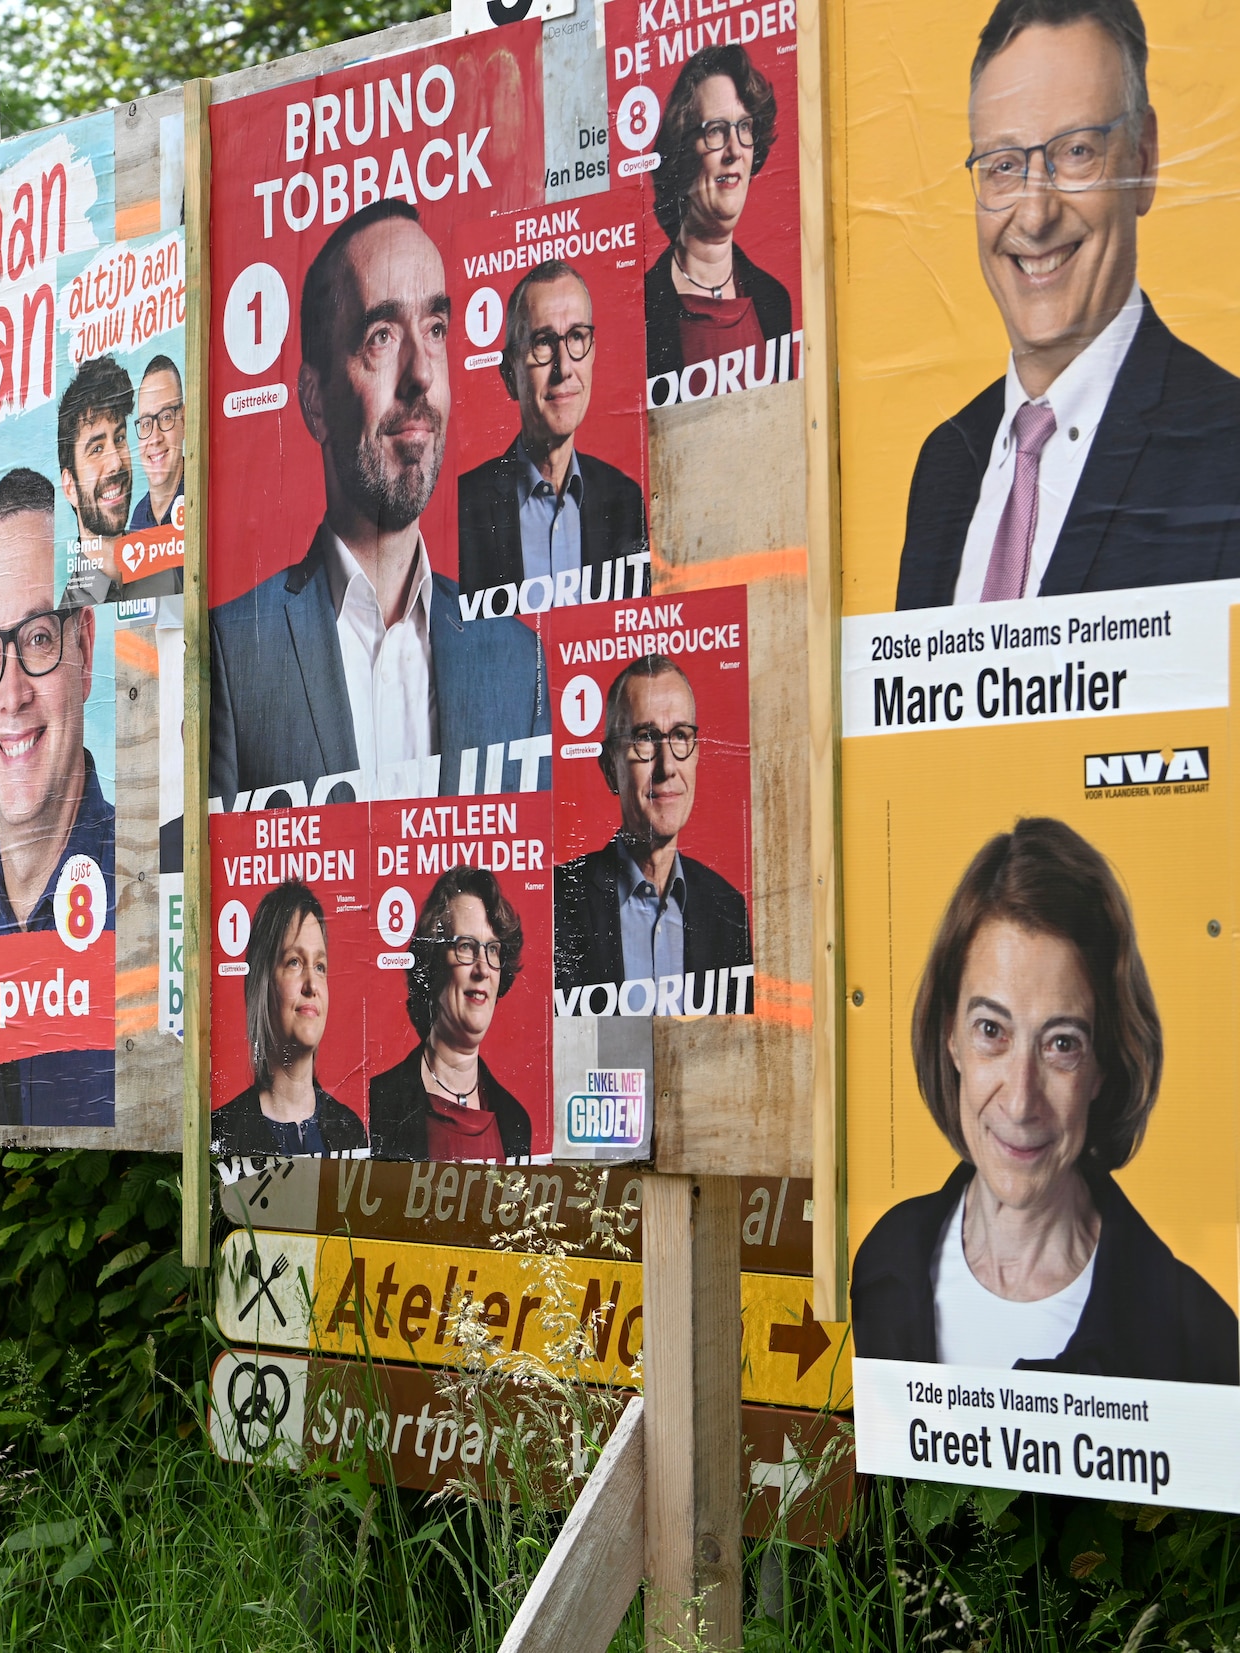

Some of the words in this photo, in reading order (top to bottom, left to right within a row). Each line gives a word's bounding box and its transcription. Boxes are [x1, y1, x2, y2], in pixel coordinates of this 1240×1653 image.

[614, 40, 651, 80] DE
[285, 63, 456, 163] BRUNO
[628, 100, 648, 135] 8
[253, 125, 493, 240] TOBBACK
[623, 157, 656, 174] Opvolger
[514, 208, 580, 243] FRANK
[140, 241, 179, 287] aan
[463, 222, 636, 280] VANDENBROUCKE
[616, 258, 636, 269] Kamer
[247, 292, 263, 345] 1
[477, 301, 488, 332] 1
[74, 308, 124, 363] jouw
[67, 535, 103, 555] Kemal
[149, 537, 185, 562] pvda
[67, 557, 104, 573] Bilmez
[614, 603, 684, 633] FRANK
[871, 633, 922, 661] 20ste
[927, 627, 985, 661] plaats
[990, 622, 1061, 650] Vlaams
[1067, 610, 1172, 643] Parlement
[559, 623, 740, 666] VANDENBROUCKE
[719, 660, 741, 671] Kamer
[574, 689, 586, 722] 1
[873, 676, 964, 727] Marc
[976, 660, 1128, 719] Charlier
[565, 746, 598, 757] Lijsttrekker
[255, 815, 322, 849] BIEKE
[400, 803, 517, 839] KATLEEN
[223, 849, 356, 887] VERLINDEN
[378, 845, 410, 876] DE
[417, 839, 545, 875] MUYLDER
[524, 882, 545, 891] Kamer
[66, 883, 93, 941] 8
[229, 913, 238, 942] 1
[388, 900, 404, 933] 8
[381, 955, 411, 967] Opvolger
[554, 963, 755, 1017] VOORUIT
[587, 1072, 619, 1093] ENKEL
[621, 1072, 643, 1093] MET
[570, 1097, 641, 1138] GROEN
[325, 1256, 541, 1352] Atelier
[906, 1381, 943, 1405] 12de
[947, 1384, 995, 1410] plaats
[999, 1389, 1059, 1414] Vlaams
[1063, 1394, 1150, 1422] Parlement
[909, 1418, 992, 1469] Greet
[1000, 1427, 1061, 1475] Van
[1072, 1433, 1171, 1495] Camp
